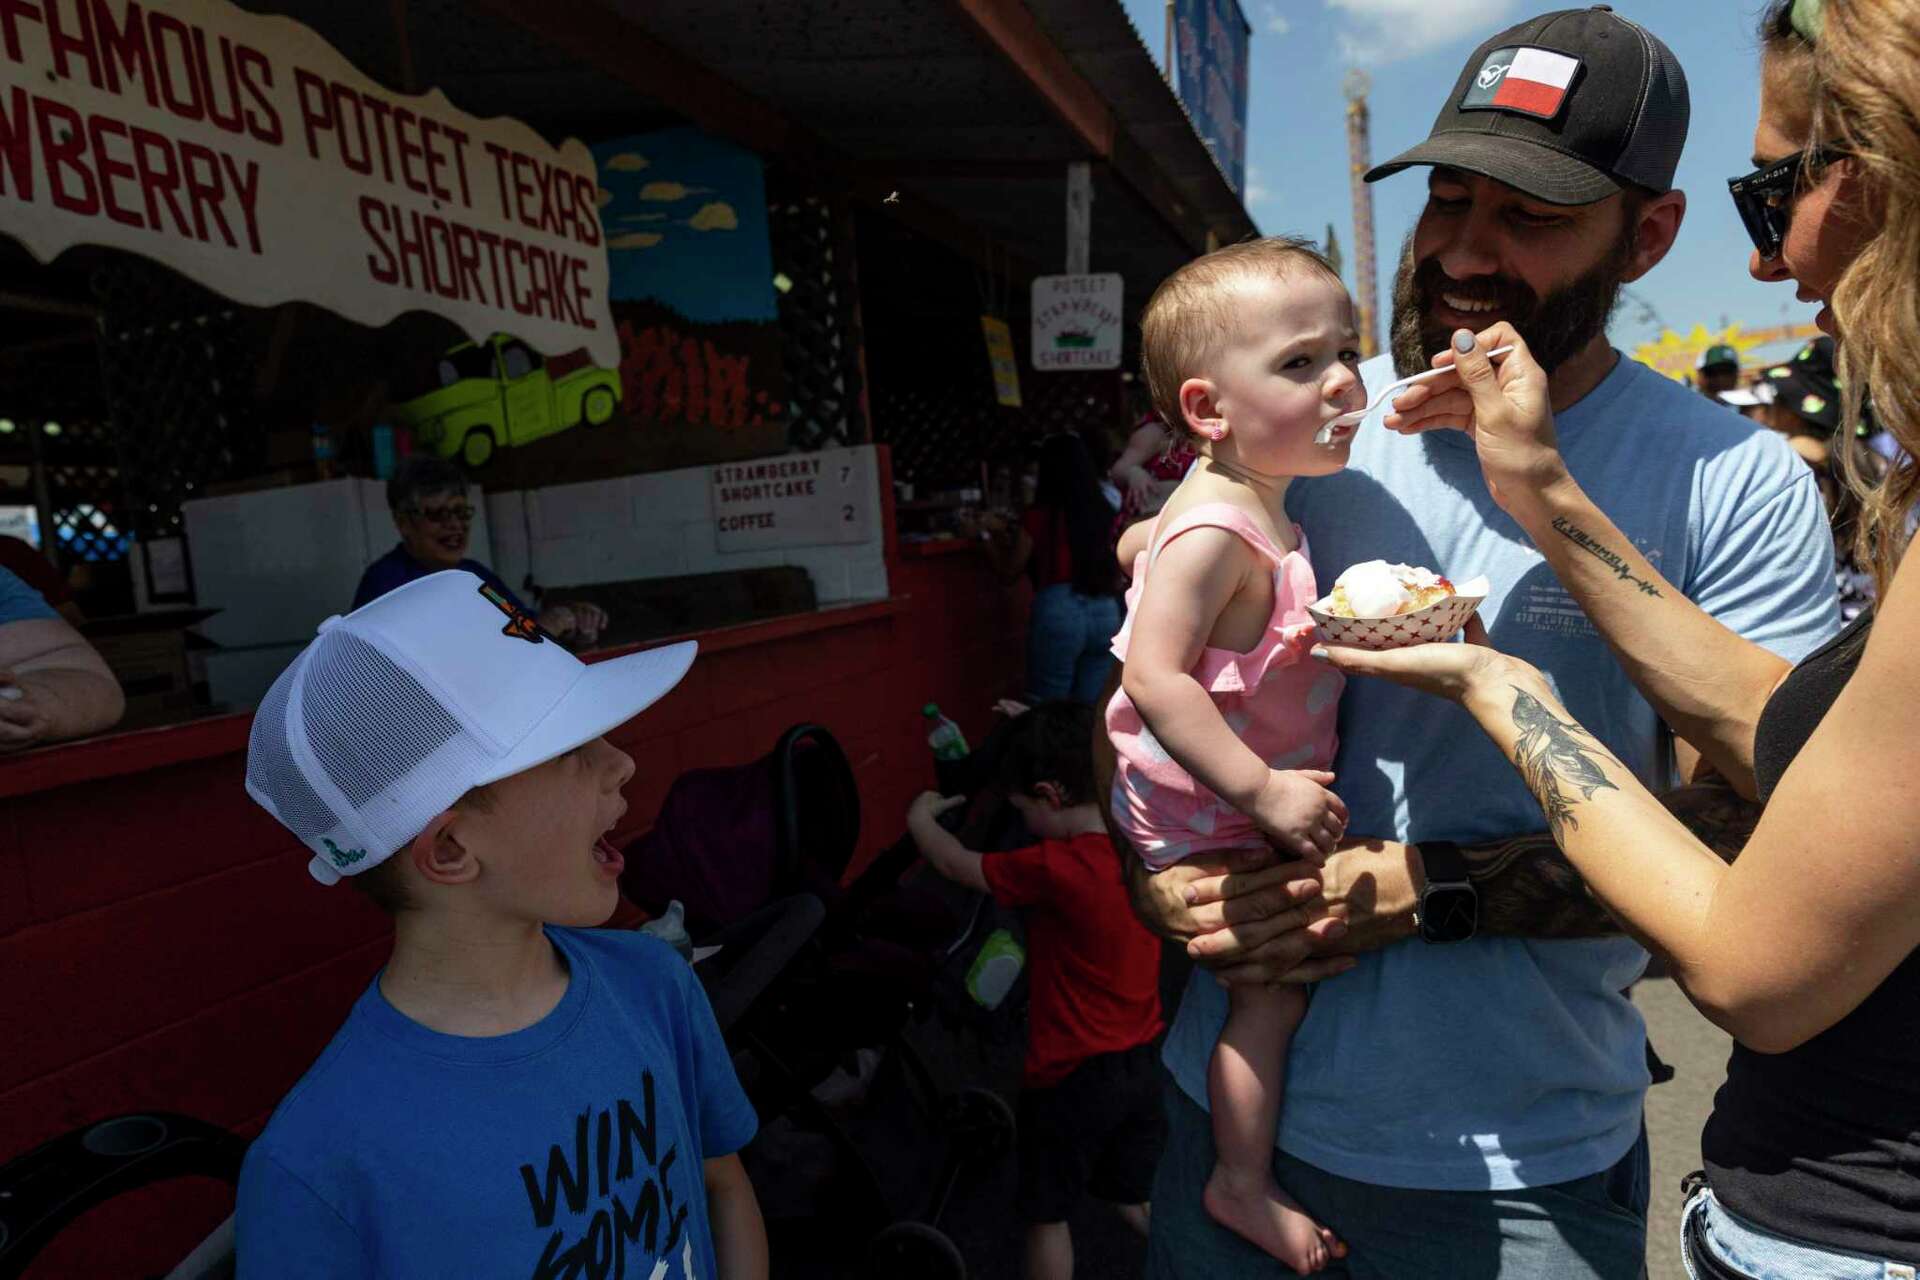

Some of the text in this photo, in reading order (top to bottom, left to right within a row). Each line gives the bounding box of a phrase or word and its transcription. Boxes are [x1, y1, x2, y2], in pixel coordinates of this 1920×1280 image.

[294, 66, 471, 209] POTEET
[484, 141, 599, 247] TEXAS
[359, 195, 597, 330] SHORTCAKE
[721, 480, 816, 503] SHORTCAKE
[841, 466, 850, 483] 7
[719, 504, 855, 532] COFFEE 2
[520, 1065, 656, 1228] WIN
